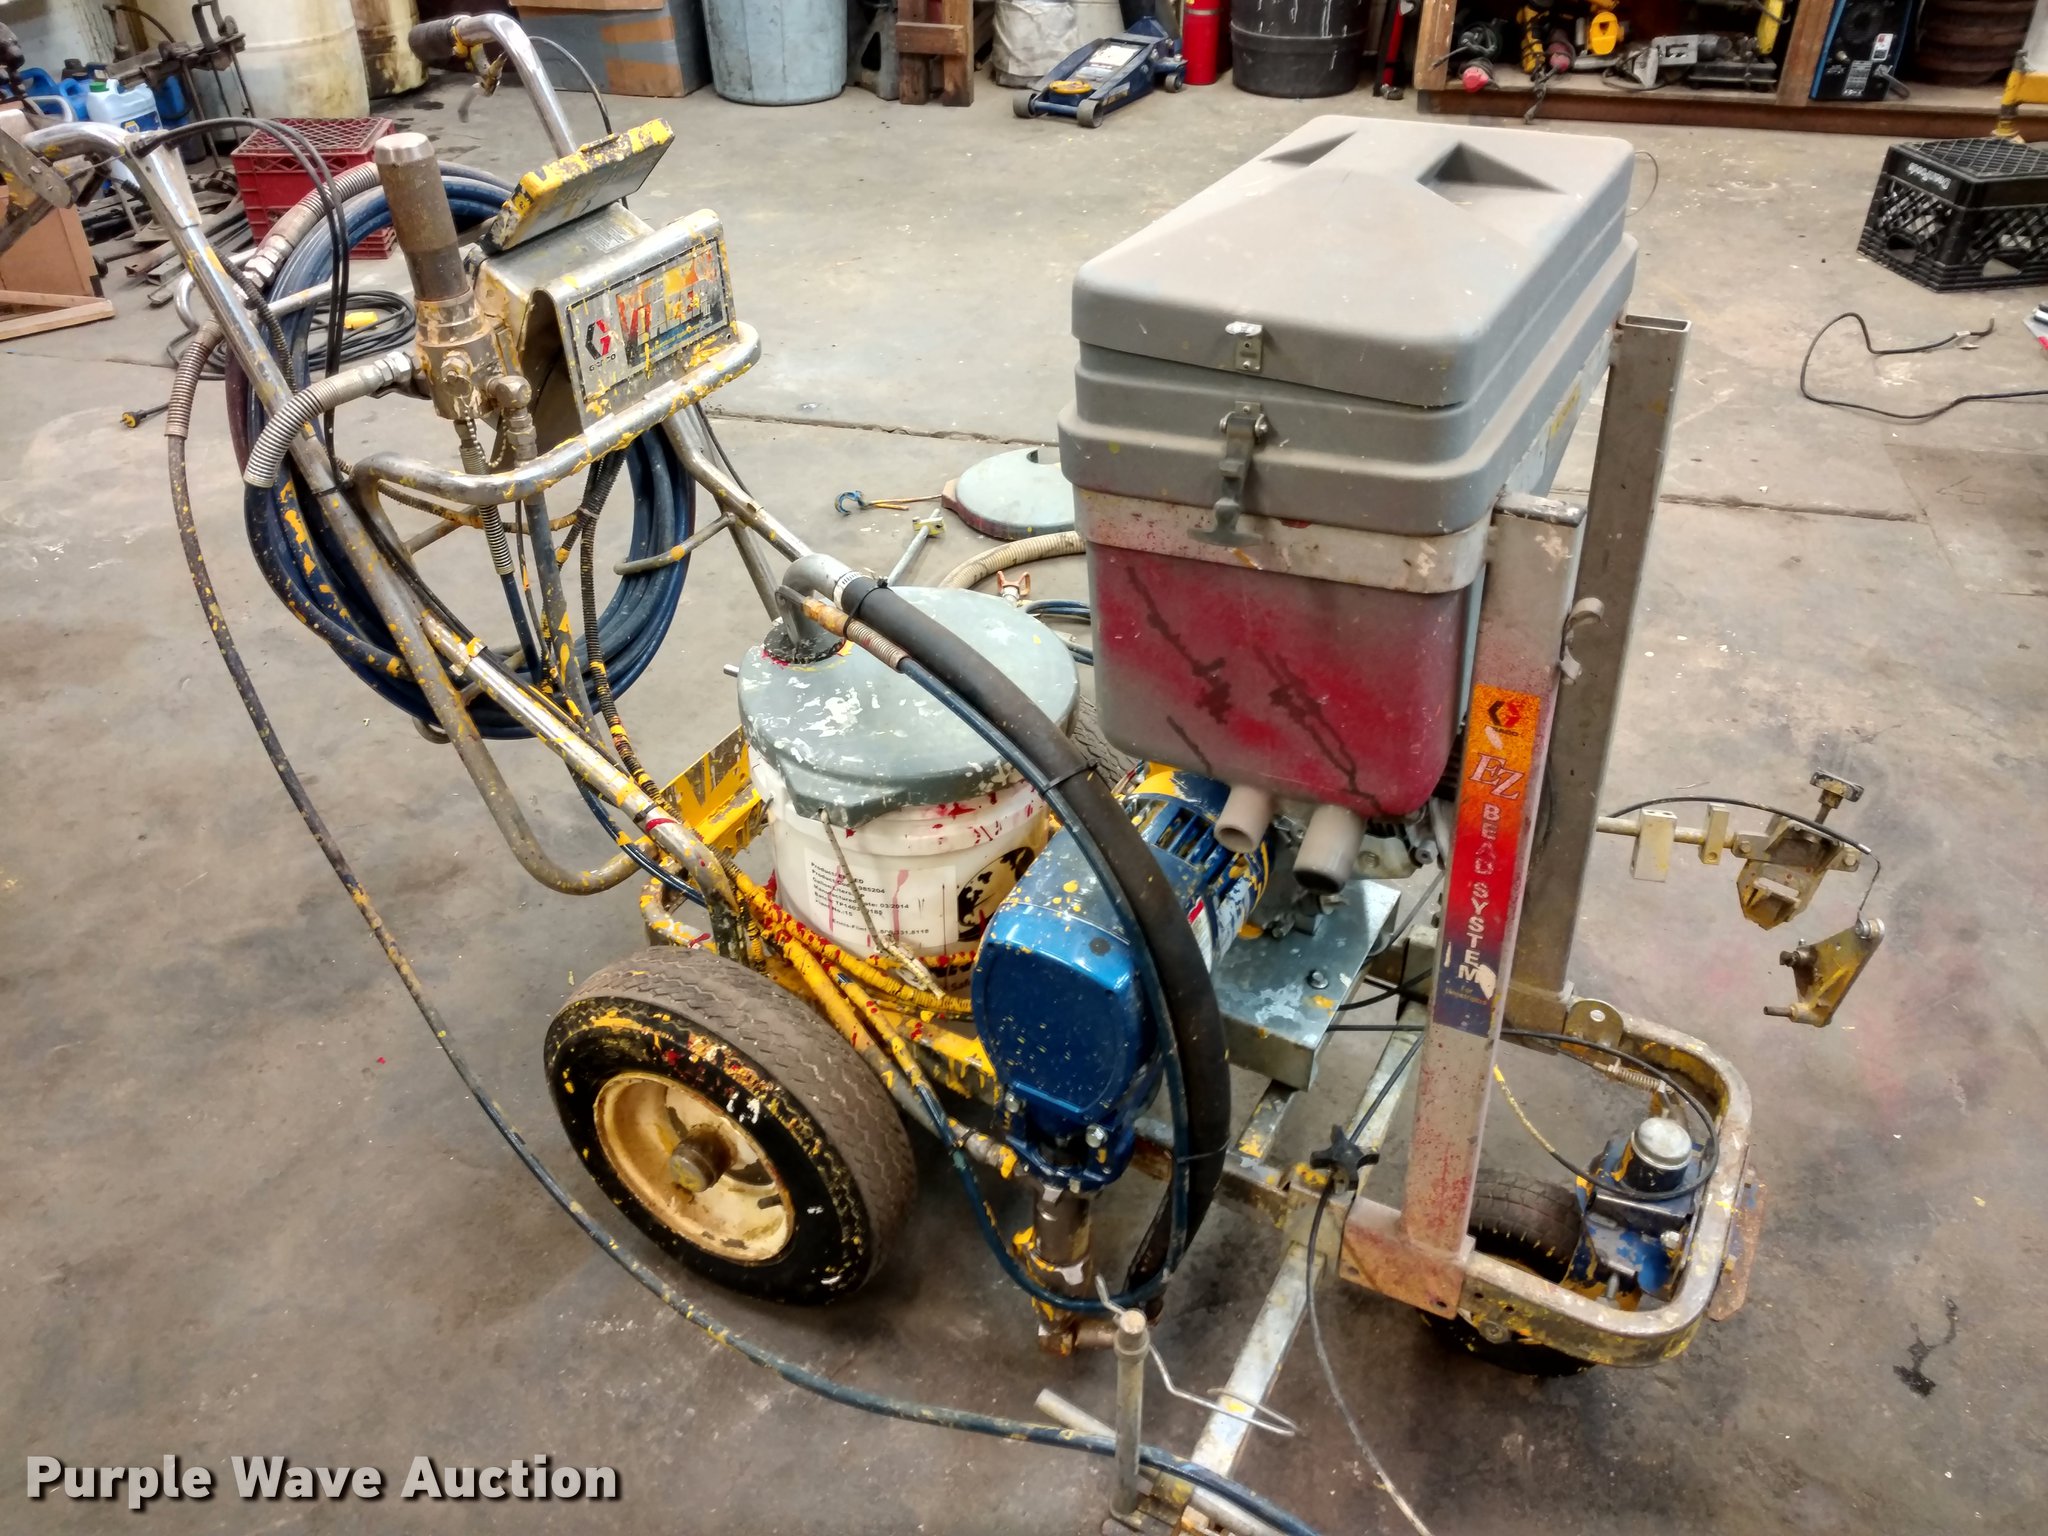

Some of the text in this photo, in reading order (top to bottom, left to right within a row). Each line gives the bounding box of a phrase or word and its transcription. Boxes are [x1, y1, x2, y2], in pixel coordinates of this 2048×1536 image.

[1469, 752, 1525, 799] EZ
[858, 885, 886, 894] 985204
[1457, 882, 1489, 985] SYSTEM
